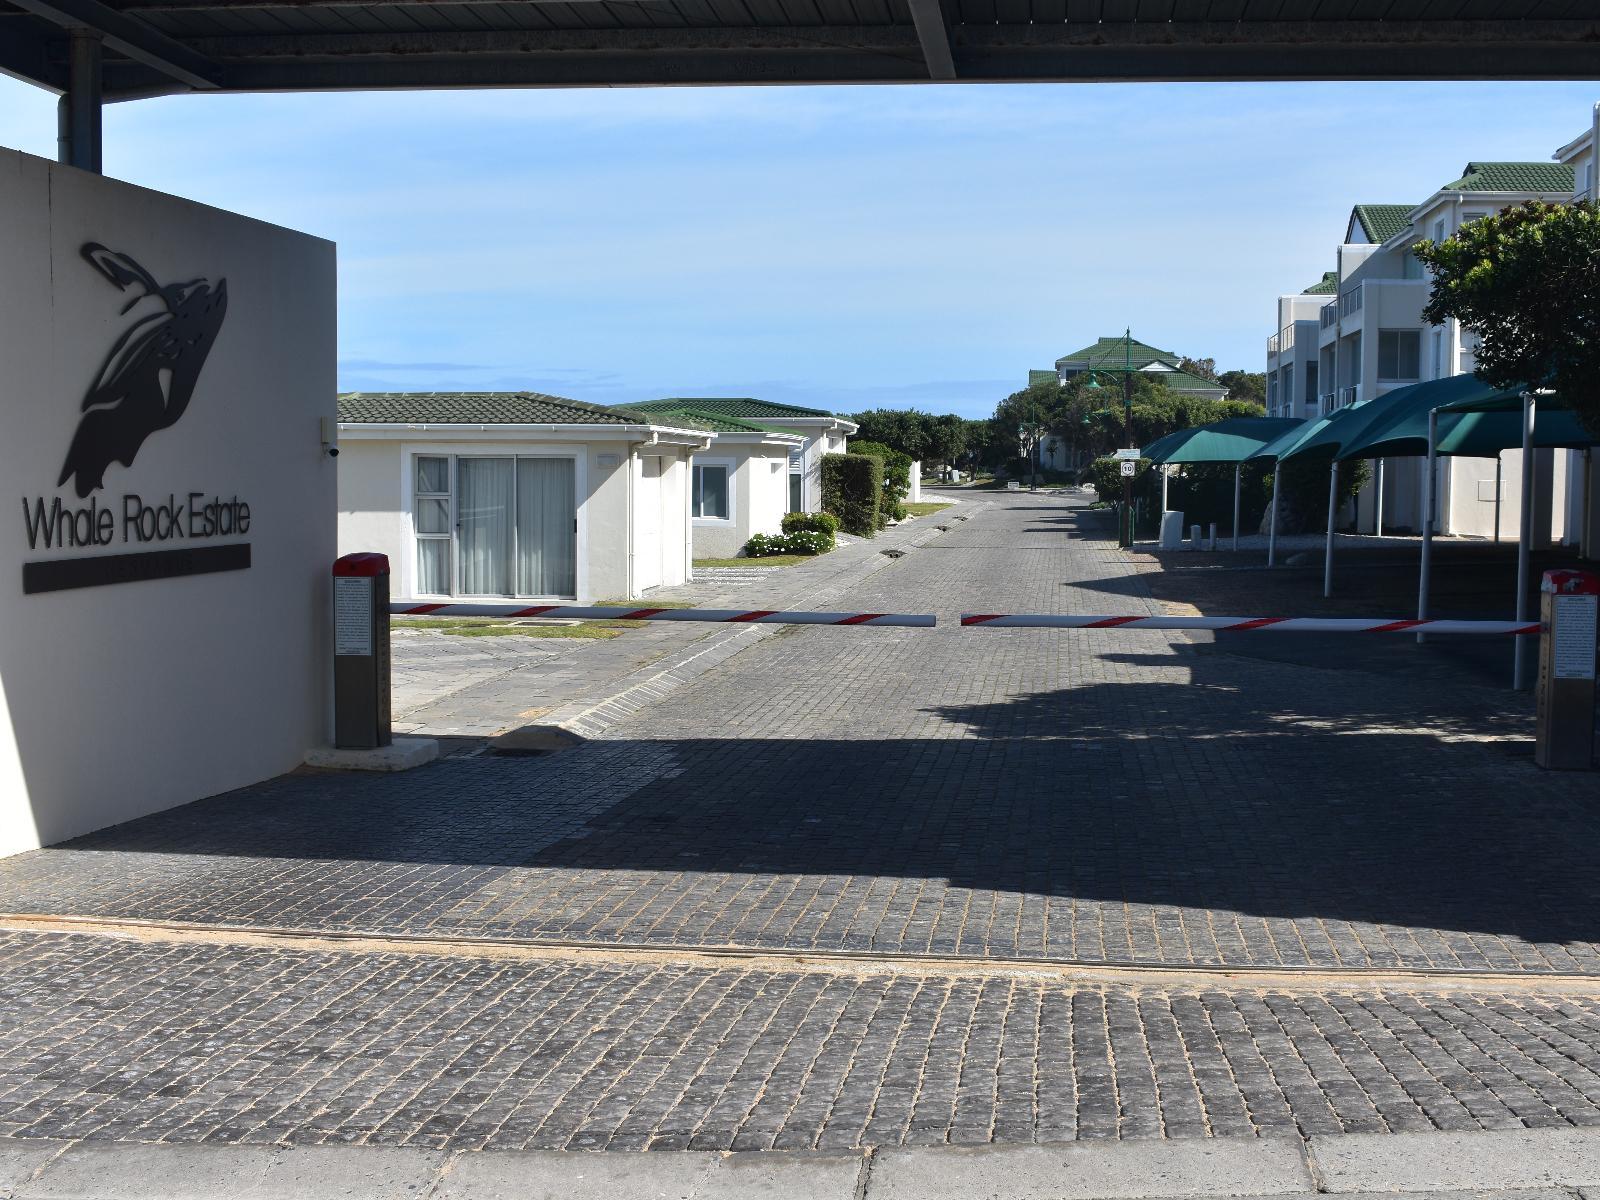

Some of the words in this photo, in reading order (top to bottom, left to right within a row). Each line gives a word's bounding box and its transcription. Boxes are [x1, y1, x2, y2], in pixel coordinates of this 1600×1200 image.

[23, 496, 114, 550] Whale
[122, 494, 185, 543] Rock
[188, 492, 251, 538] Estate
